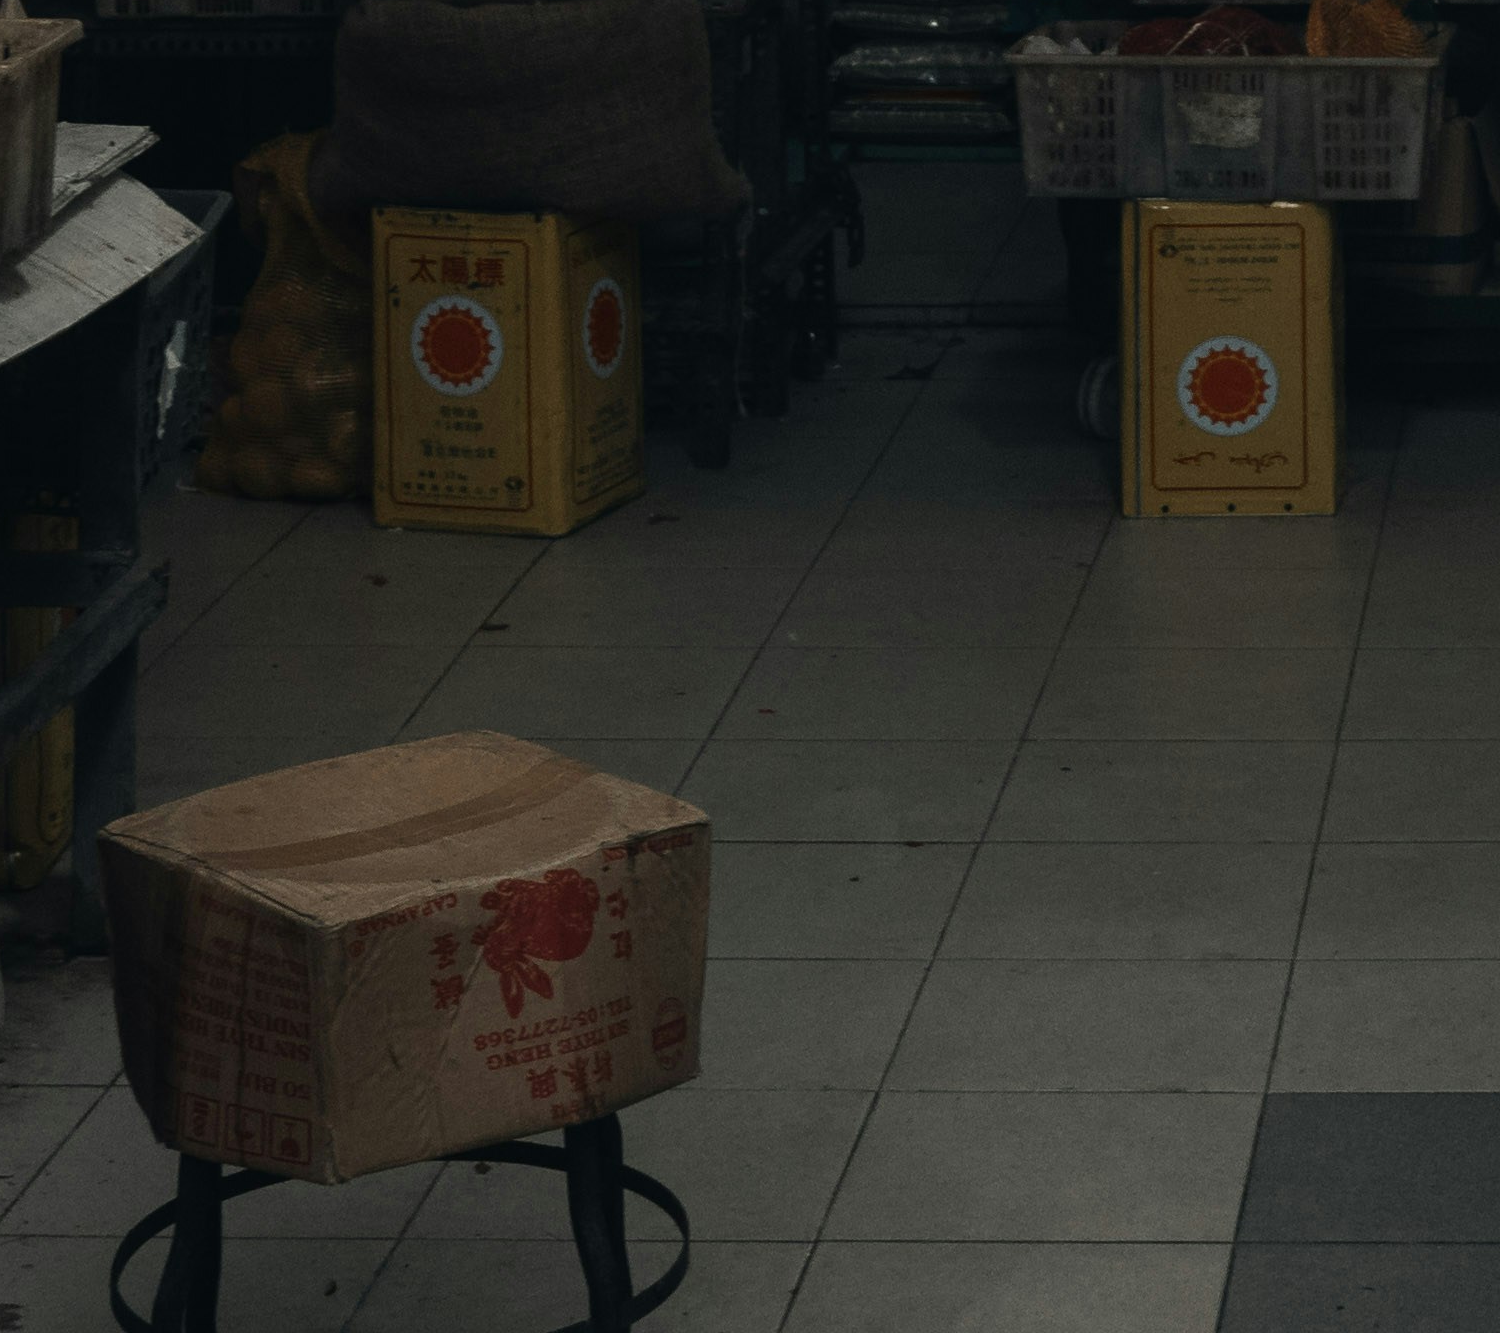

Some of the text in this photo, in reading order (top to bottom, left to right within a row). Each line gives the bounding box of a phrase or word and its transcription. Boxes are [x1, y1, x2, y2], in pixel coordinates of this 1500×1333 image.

[409, 253, 506, 287] 太陽標
[557, 1028, 607, 1055] THYE
[485, 1042, 553, 1071] HENG
